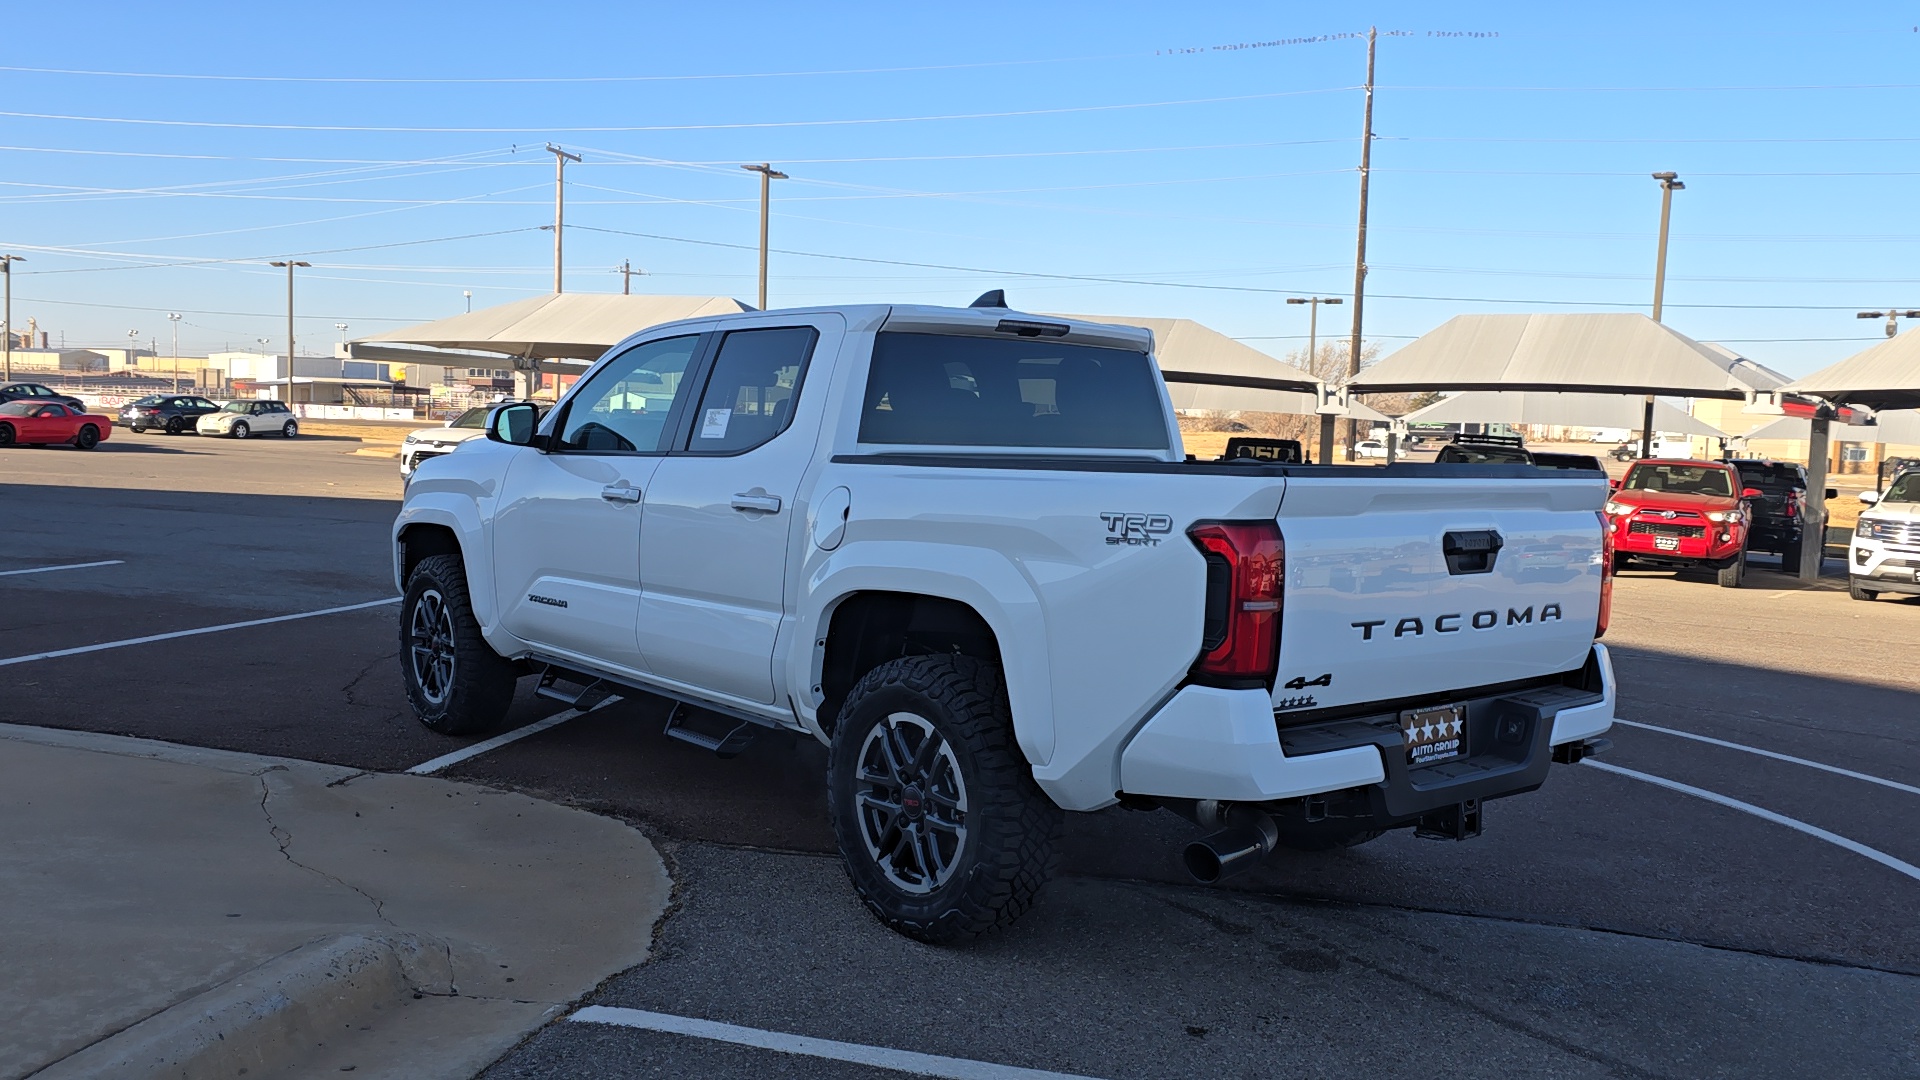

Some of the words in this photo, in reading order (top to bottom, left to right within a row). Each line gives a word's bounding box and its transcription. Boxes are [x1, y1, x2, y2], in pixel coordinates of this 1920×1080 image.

[1100, 512, 1173, 538] TRD
[1105, 537, 1161, 547] SPORT
[1351, 603, 1562, 641] TACOMA
[1411, 744, 1434, 758] AUTO
[1434, 739, 1460, 752] GROUP
